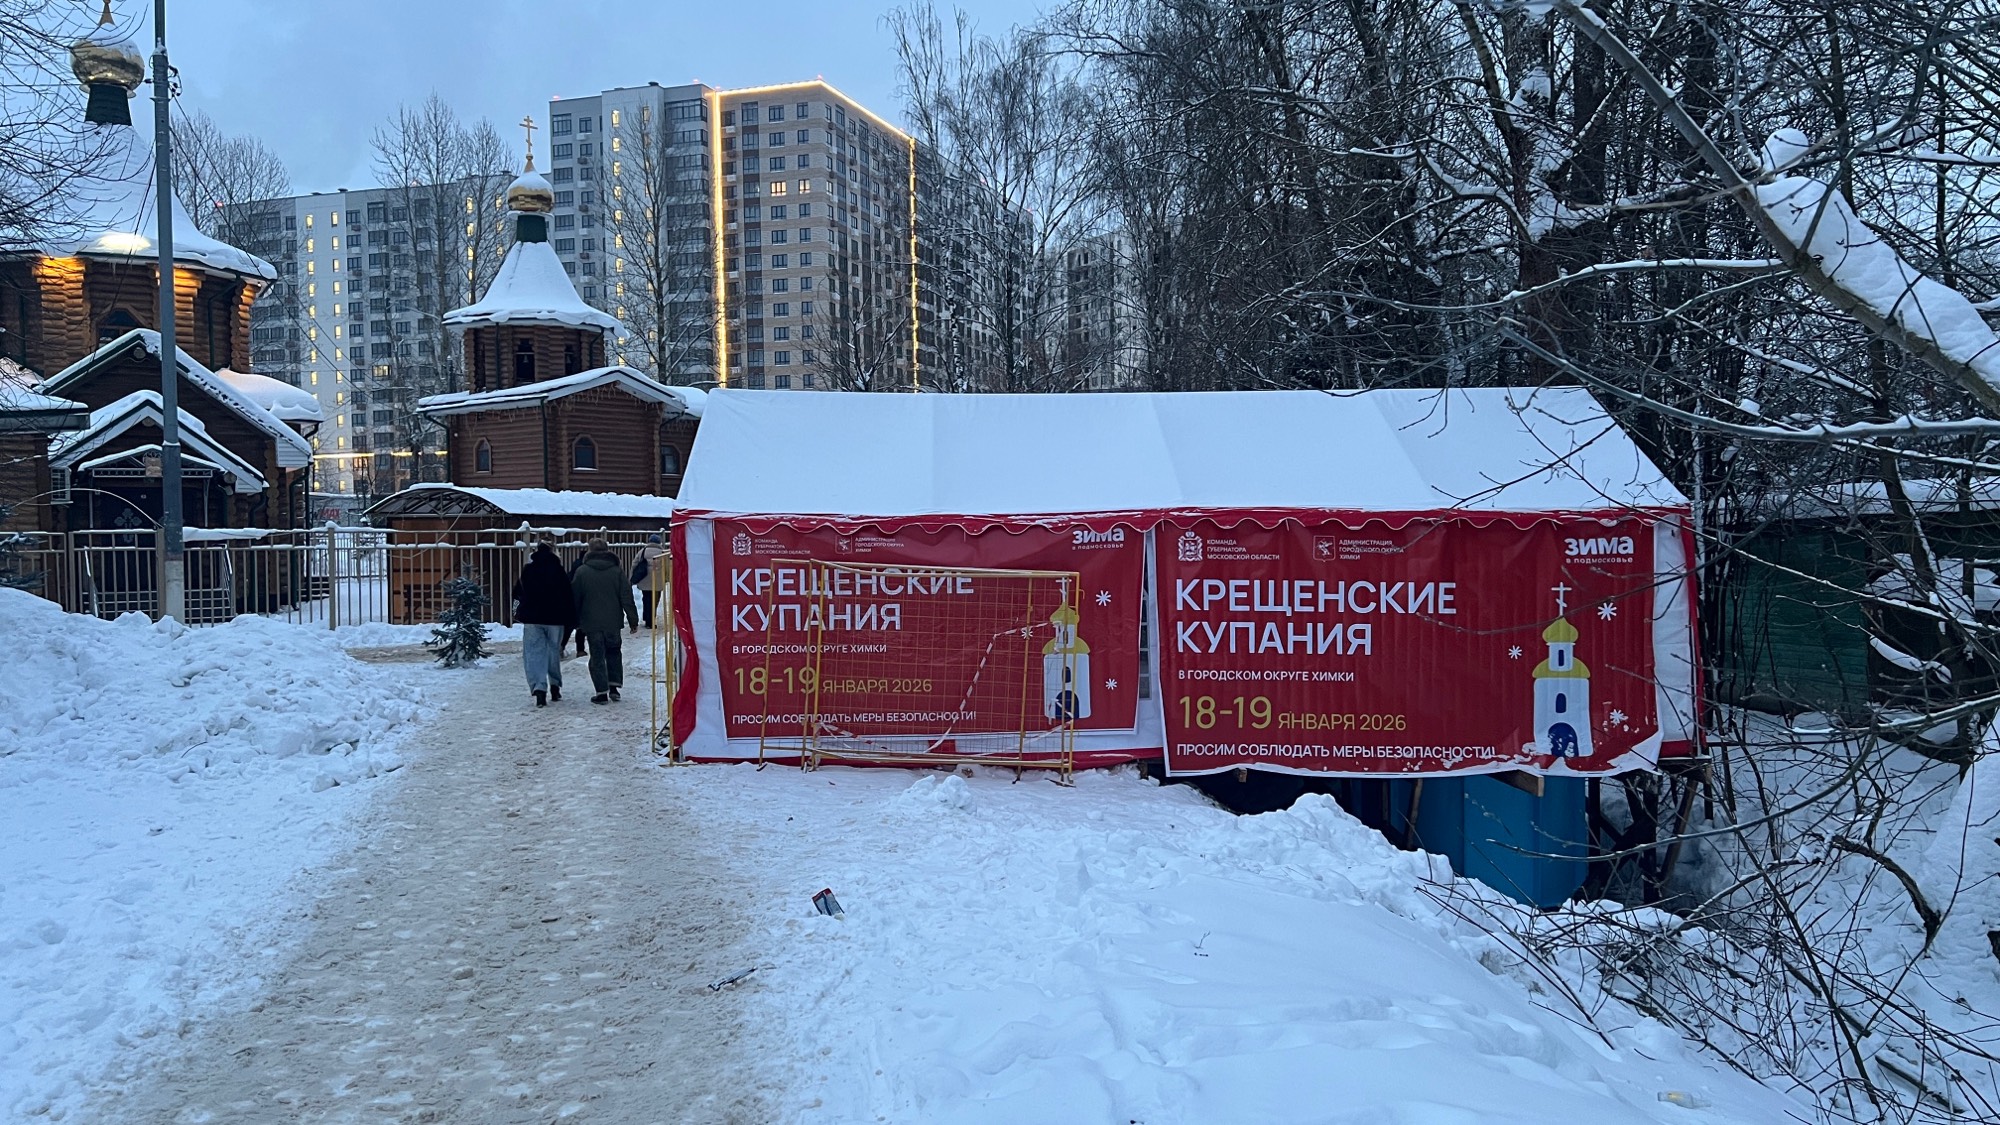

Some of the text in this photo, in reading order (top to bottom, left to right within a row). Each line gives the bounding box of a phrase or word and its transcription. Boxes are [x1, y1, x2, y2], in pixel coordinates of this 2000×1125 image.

[731, 568, 974, 599] КРЕЩЕНСКИЕ
[1176, 579, 1457, 616] КРЕЩЕНСКИЕ
[732, 603, 901, 632] КУПАНИЯ
[732, 645, 739, 654] В
[741, 645, 808, 654] ГОРОДСКОМ
[850, 644, 887, 653] ХИМКИ
[1176, 621, 1372, 655] КУПАНИЯ
[734, 667, 933, 695] 18-19 ЯНВАРЯ 2026
[1178, 670, 1354, 682] В ГОРОДСКОМ ОКРУГЕ ХИМКИ
[732, 714, 780, 724] ПРОСИМ
[853, 713, 884, 722] МЕРЫ
[1179, 695, 1407, 731] 18-19 ЯНВАРЯ 2026
[1177, 743, 1495, 758] ПРОСИМ СОБЛЮДАТЬ МЕРЫ БЕЗОПАСНОСТИ!
